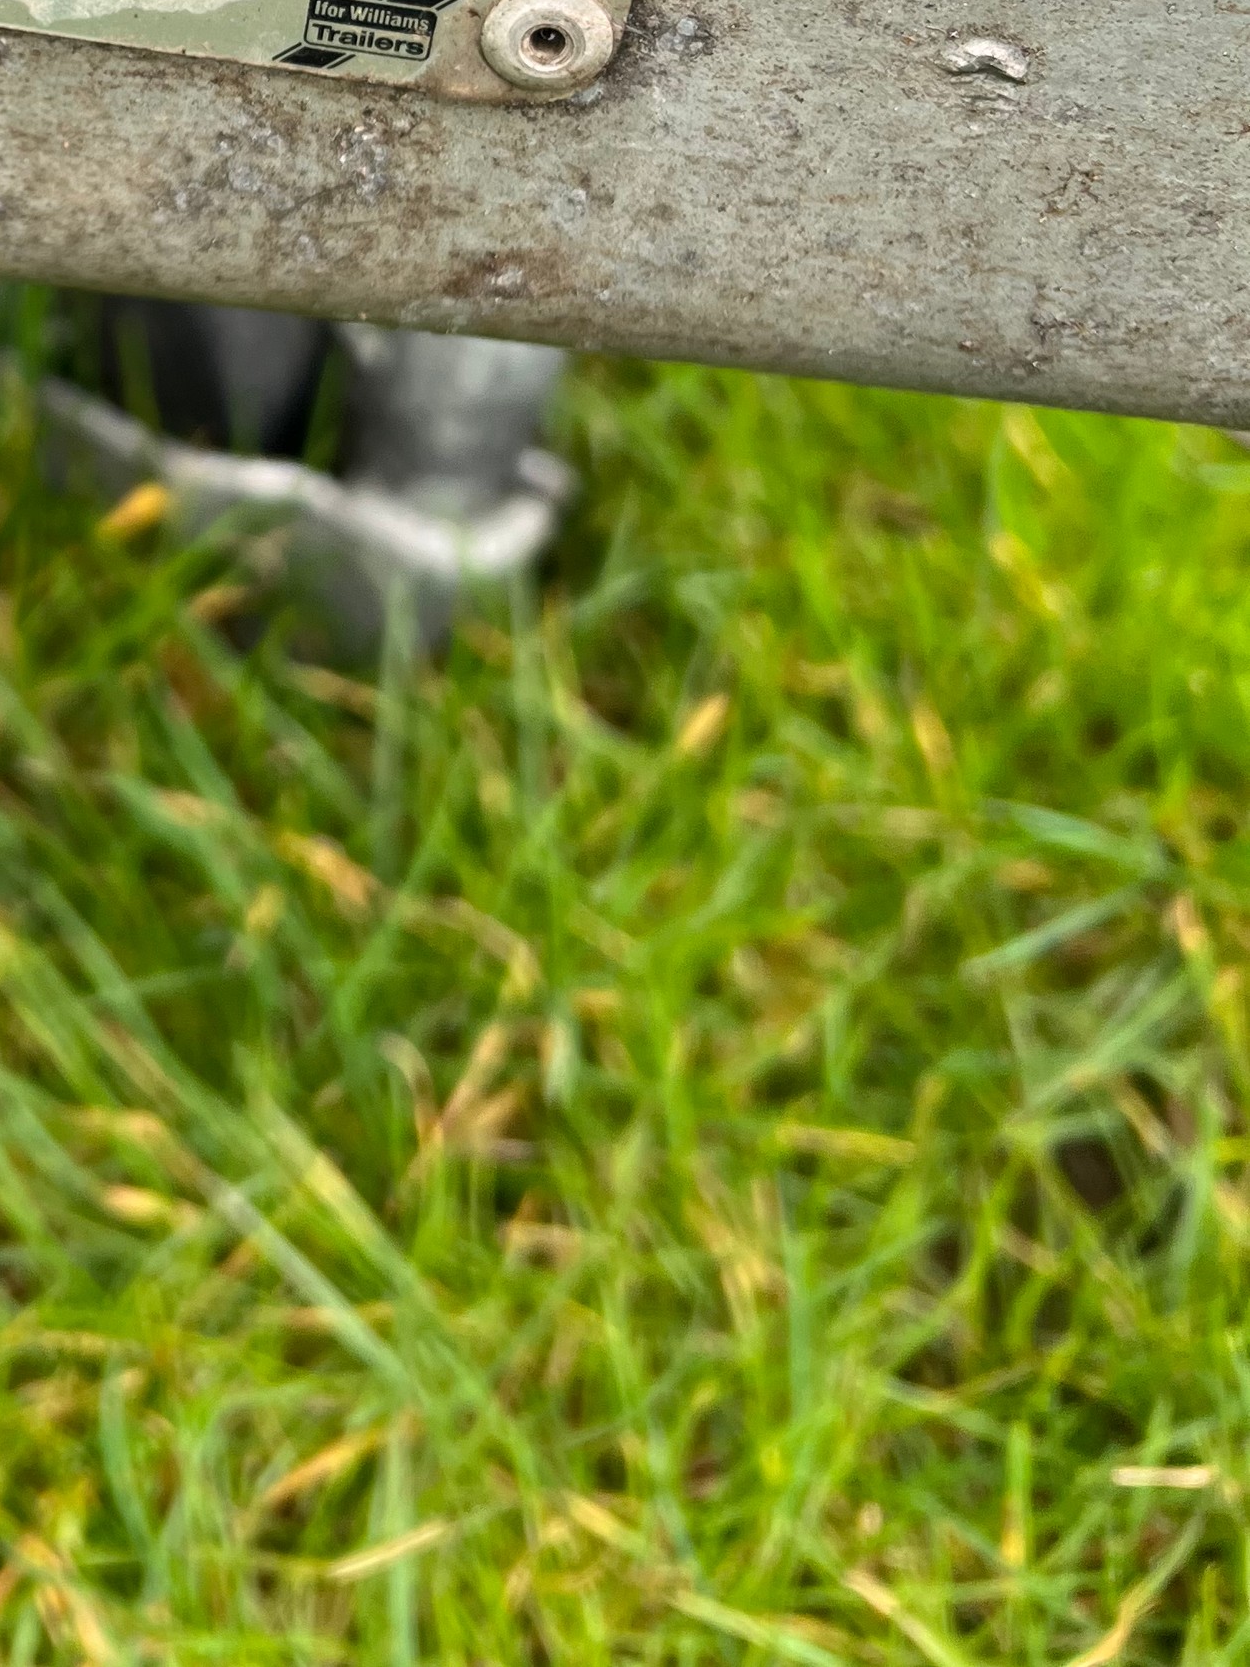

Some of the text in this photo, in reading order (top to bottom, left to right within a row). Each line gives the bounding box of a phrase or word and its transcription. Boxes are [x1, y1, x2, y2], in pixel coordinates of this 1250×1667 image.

[314, 0, 431, 32] Ifor Williams
[311, 22, 426, 57] Trailers
